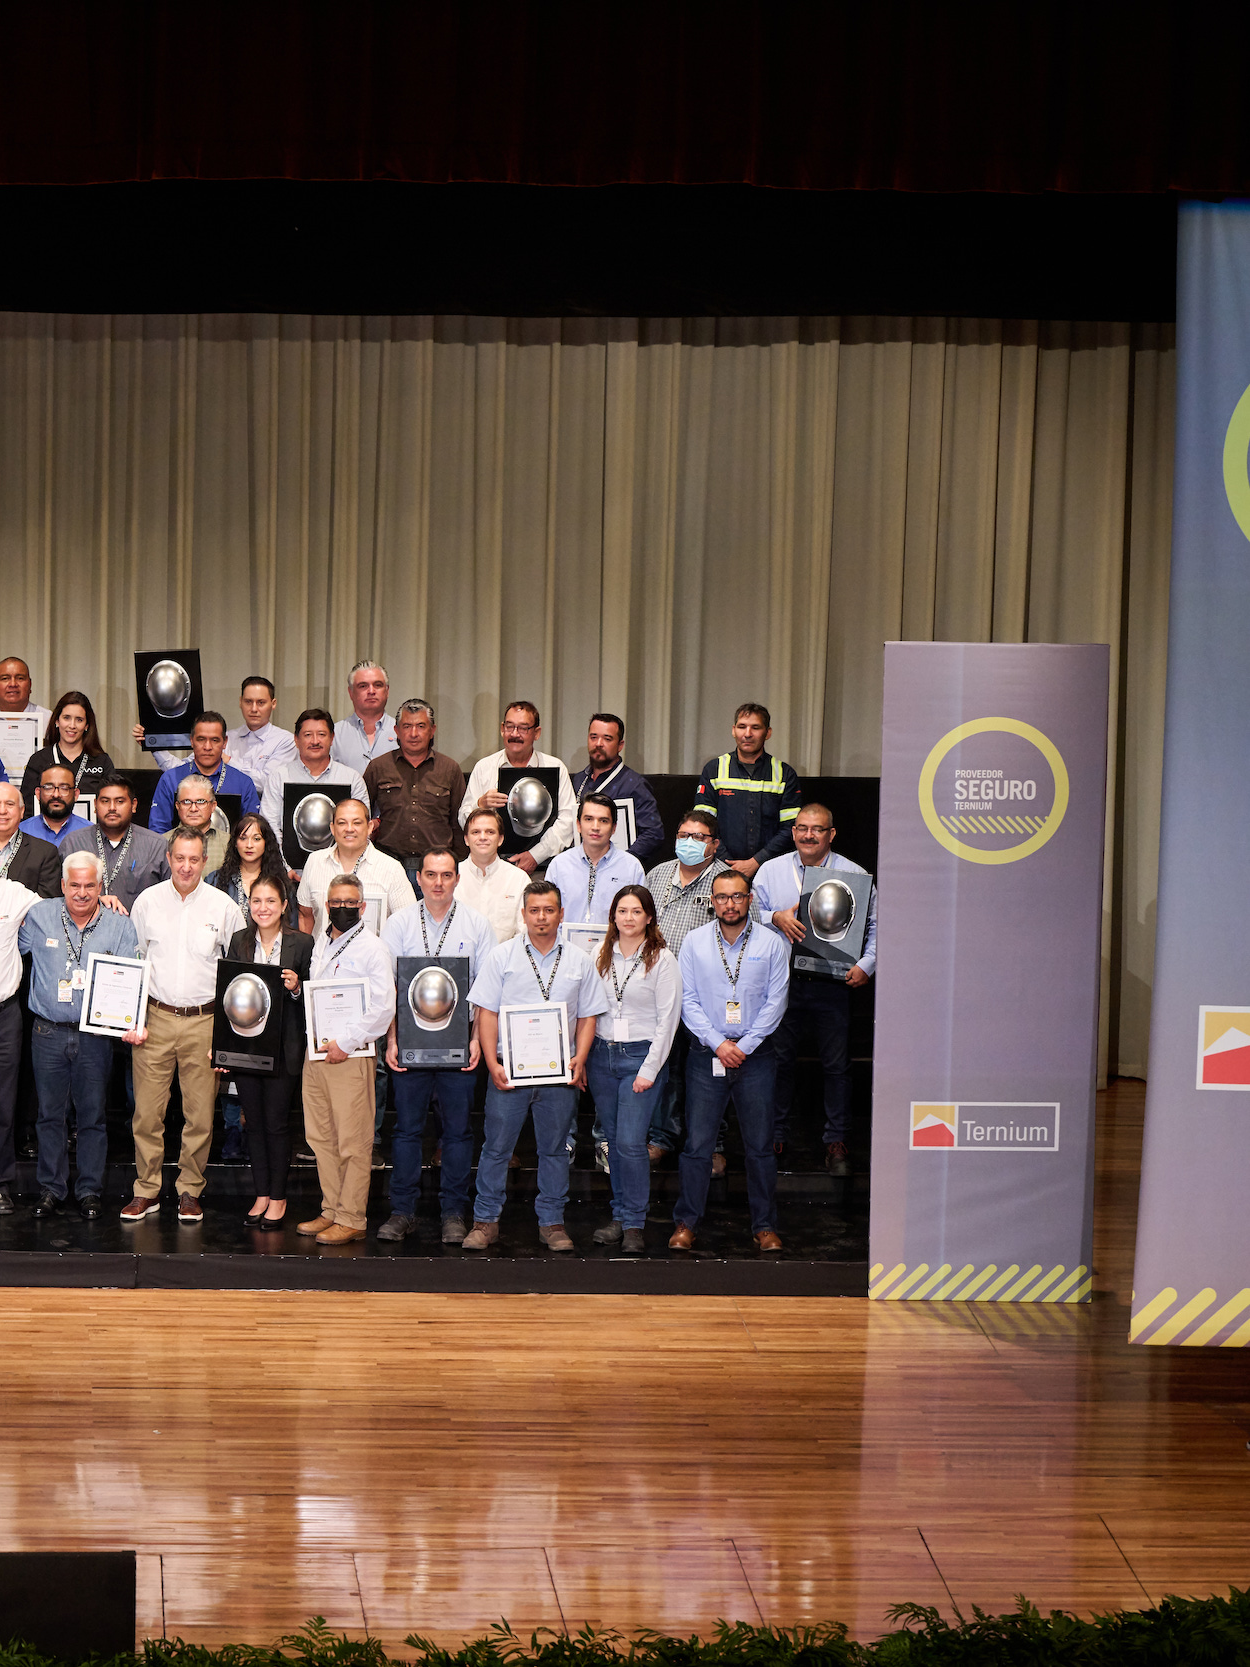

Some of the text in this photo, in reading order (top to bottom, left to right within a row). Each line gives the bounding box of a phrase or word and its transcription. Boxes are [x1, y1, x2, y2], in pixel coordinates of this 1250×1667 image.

[955, 769, 1003, 779] PROVEEDOR
[954, 779, 1037, 801] SEGURO
[954, 801, 993, 811] TERNIUM
[962, 1120, 1048, 1142] Ternium
